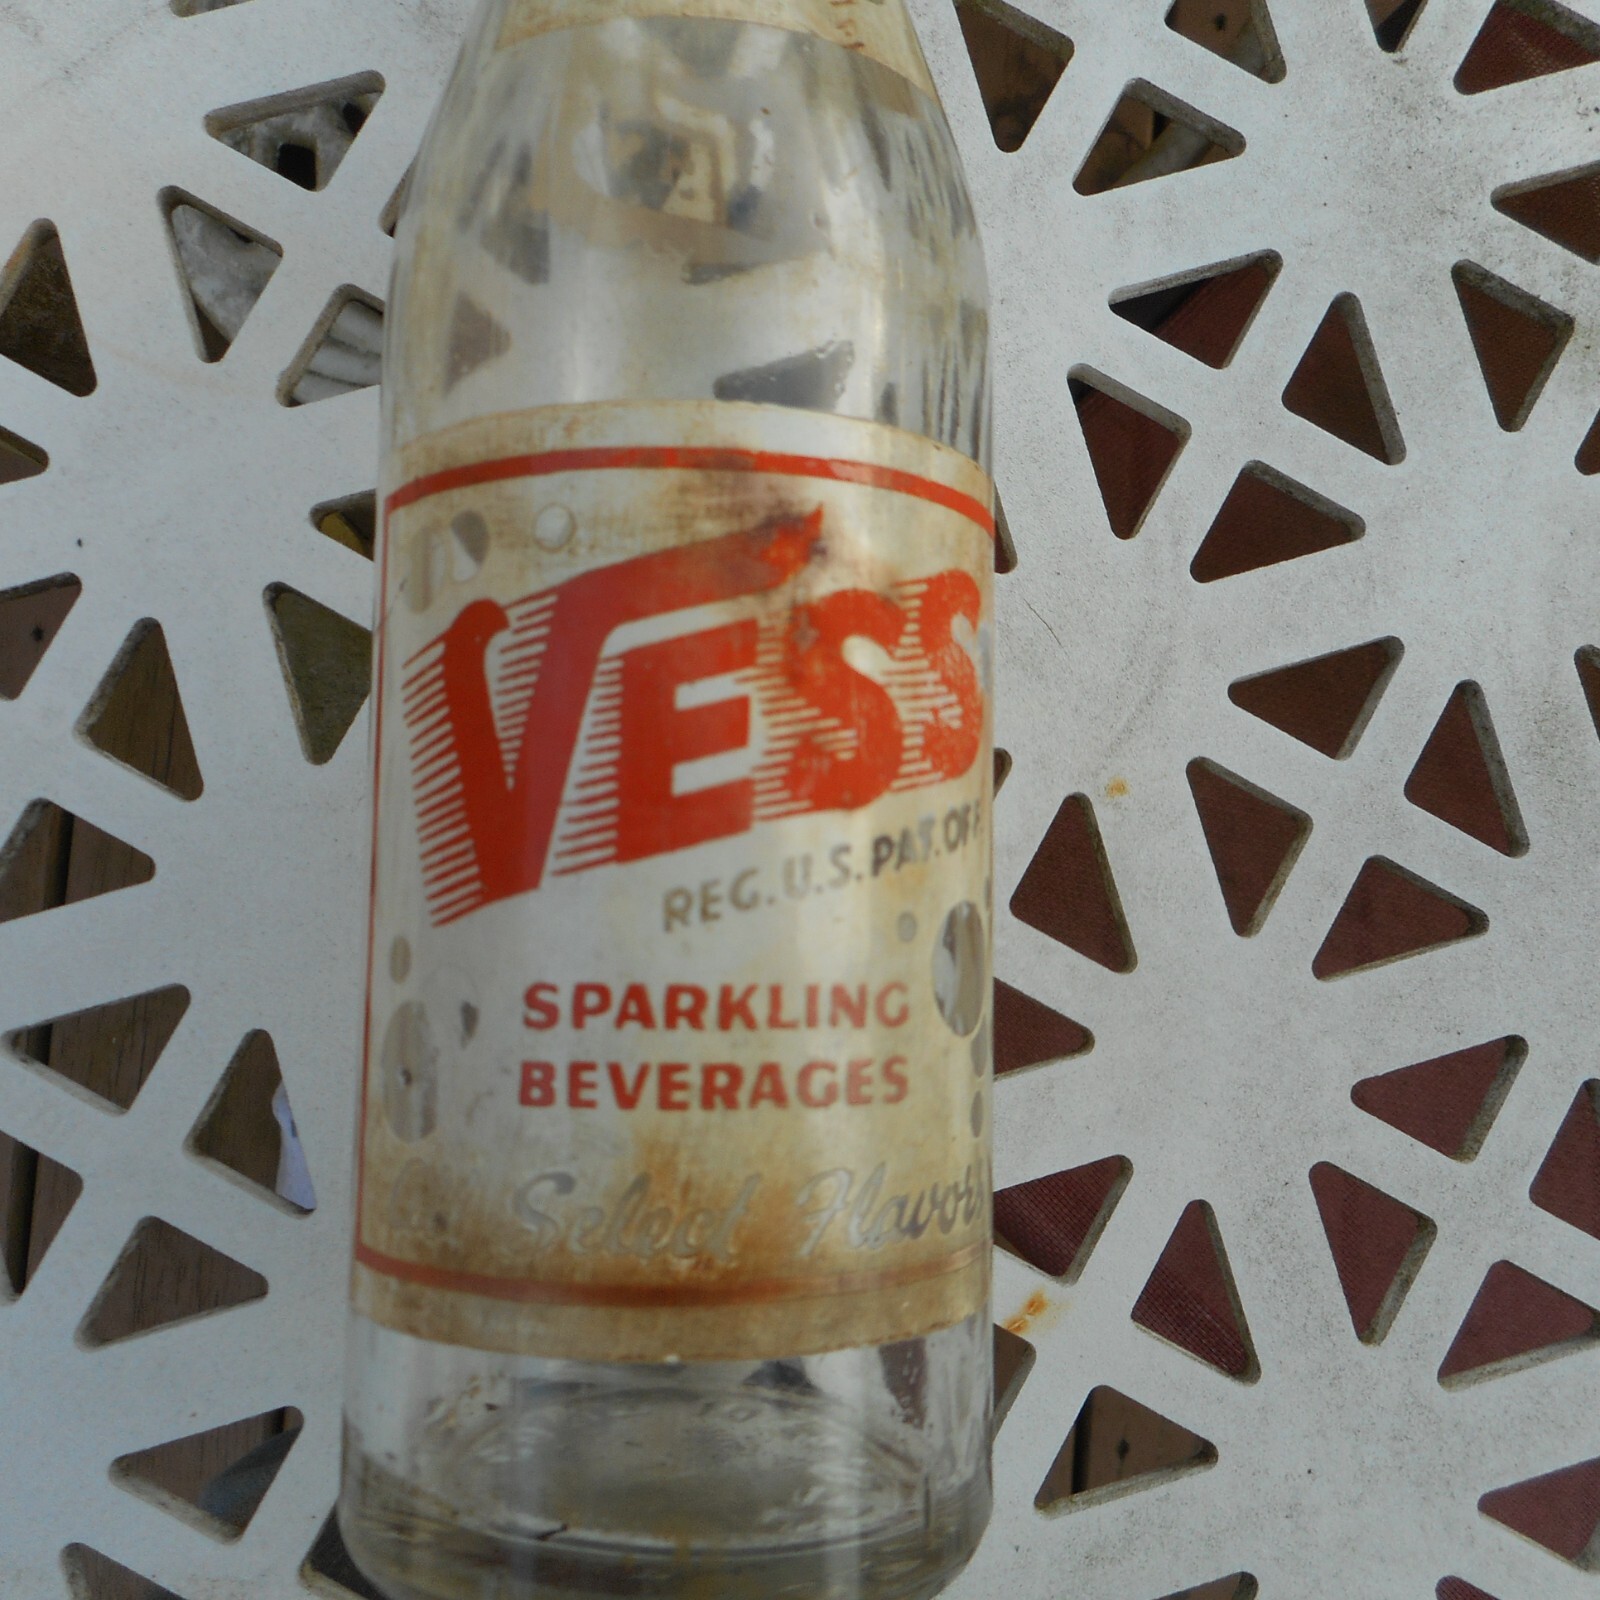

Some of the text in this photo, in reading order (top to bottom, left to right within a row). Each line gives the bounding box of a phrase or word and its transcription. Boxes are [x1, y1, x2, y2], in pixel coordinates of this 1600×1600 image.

[402, 504, 983, 926] VESS
[523, 982, 910, 1031] SPARKLING
[518, 1056, 910, 1110] BEVERAGES
